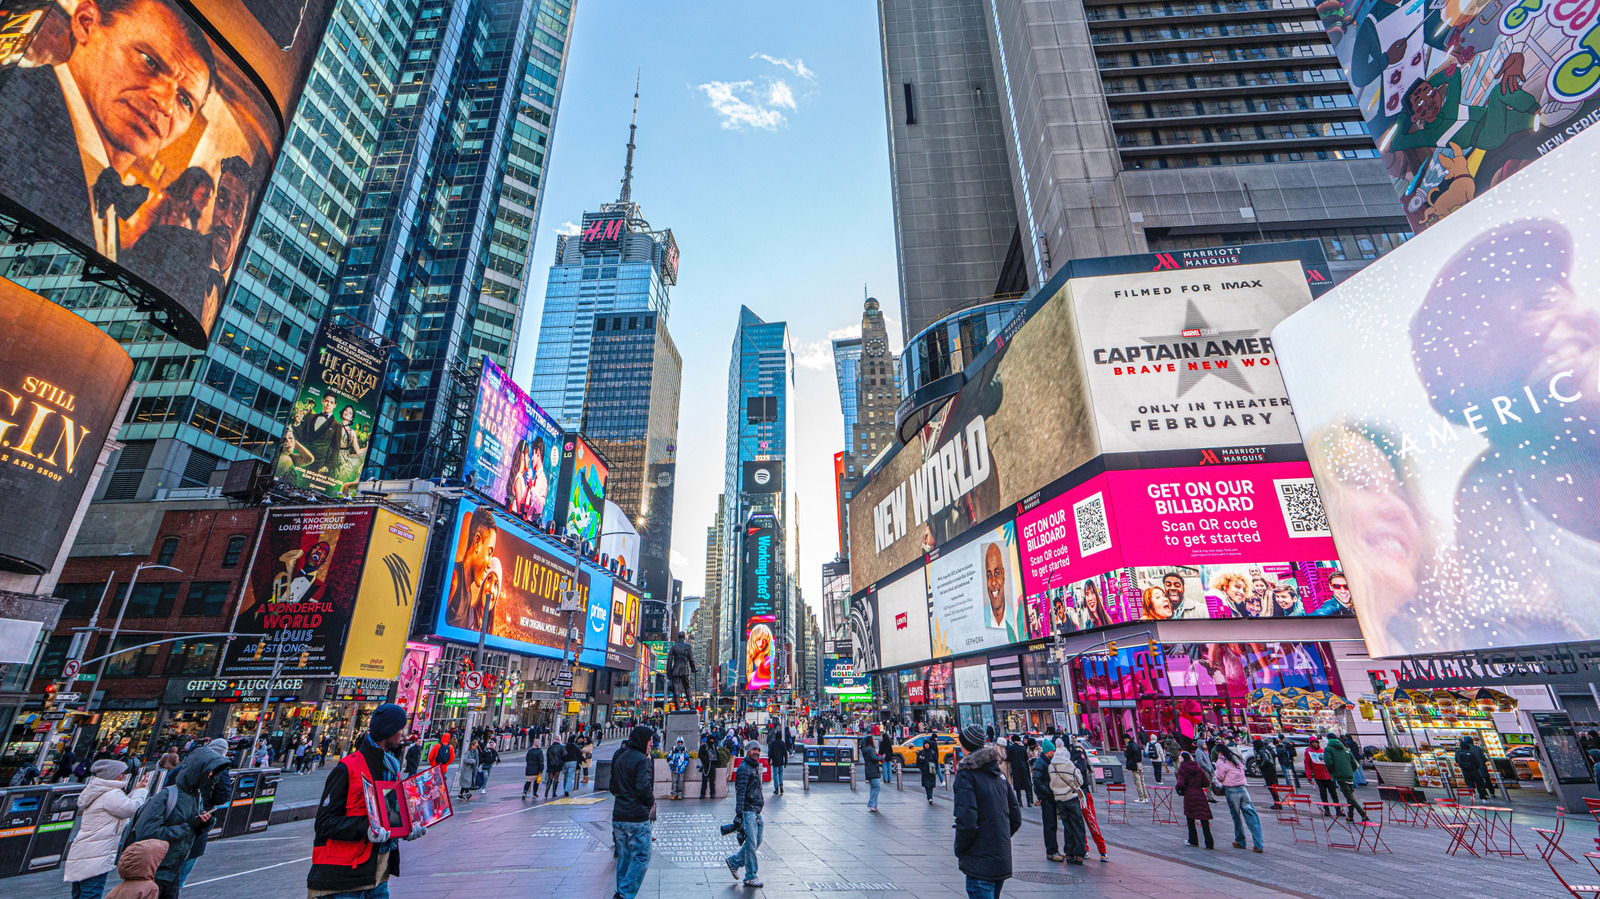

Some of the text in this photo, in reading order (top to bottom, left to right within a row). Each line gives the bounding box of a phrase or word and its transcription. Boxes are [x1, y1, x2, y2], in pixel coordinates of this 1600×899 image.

[583, 219, 623, 242] H&M
[1183, 248, 1242, 258] MARRIOTT
[1185, 256, 1238, 267] MARQUIS
[1114, 280, 1264, 298] FILMED FOR IMAX
[1093, 341, 1200, 366] CAPTAIN
[319, 351, 341, 372] THE
[341, 362, 379, 390] GREAT
[1113, 358, 1278, 376] BRAVE NEW WO
[321, 369, 370, 398] GATSBY
[22, 376, 75, 411] STILL
[484, 385, 517, 422] MAYBE
[1138, 397, 1290, 415] ONLY IN THEATER
[1401, 358, 1600, 460] AMERIC
[482, 400, 515, 431] HAPPY
[1130, 412, 1272, 432] FEBRUARY
[1222, 447, 1266, 456] MARRIOTT
[1223, 454, 1264, 462] MARQUIS
[13, 458, 34, 470] AND
[37, 466, 62, 482] SNOOP
[873, 415, 990, 556] NEW WORLD
[1147, 480, 1255, 498] GET ON OUR
[1024, 491, 1041, 504] MARRIOTT
[1024, 498, 1040, 510] MARQUIS
[1155, 496, 1254, 515] BILLBOARD
[1023, 509, 1066, 539] GET ON OUR
[1161, 517, 1257, 532] Scan QR code
[1026, 525, 1066, 552] BILLBOARD
[1164, 531, 1261, 547] to get started
[755, 535, 771, 575] Working
[1030, 544, 1068, 566] Scan QR code
[1031, 555, 1070, 577] to get started
[757, 575, 771, 600] late?
[256, 602, 334, 613] A WONDERFUL
[590, 603, 607, 621] prime
[263, 614, 322, 629] WORLD
[520, 616, 529, 628] NEW
[529, 618, 546, 632] ORIGINAL
[546, 621, 556, 634] MOVIE
[273, 629, 314, 642] LOUIS
[965, 636, 984, 646] SEPHORA
[243, 643, 305, 653] ARSTRONG
[1029, 643, 1045, 652] SEPHORA
[187, 680, 227, 691] GIFTS
[360, 678, 391, 690] LUGGAGE
[1025, 686, 1056, 697] SEPHORA
